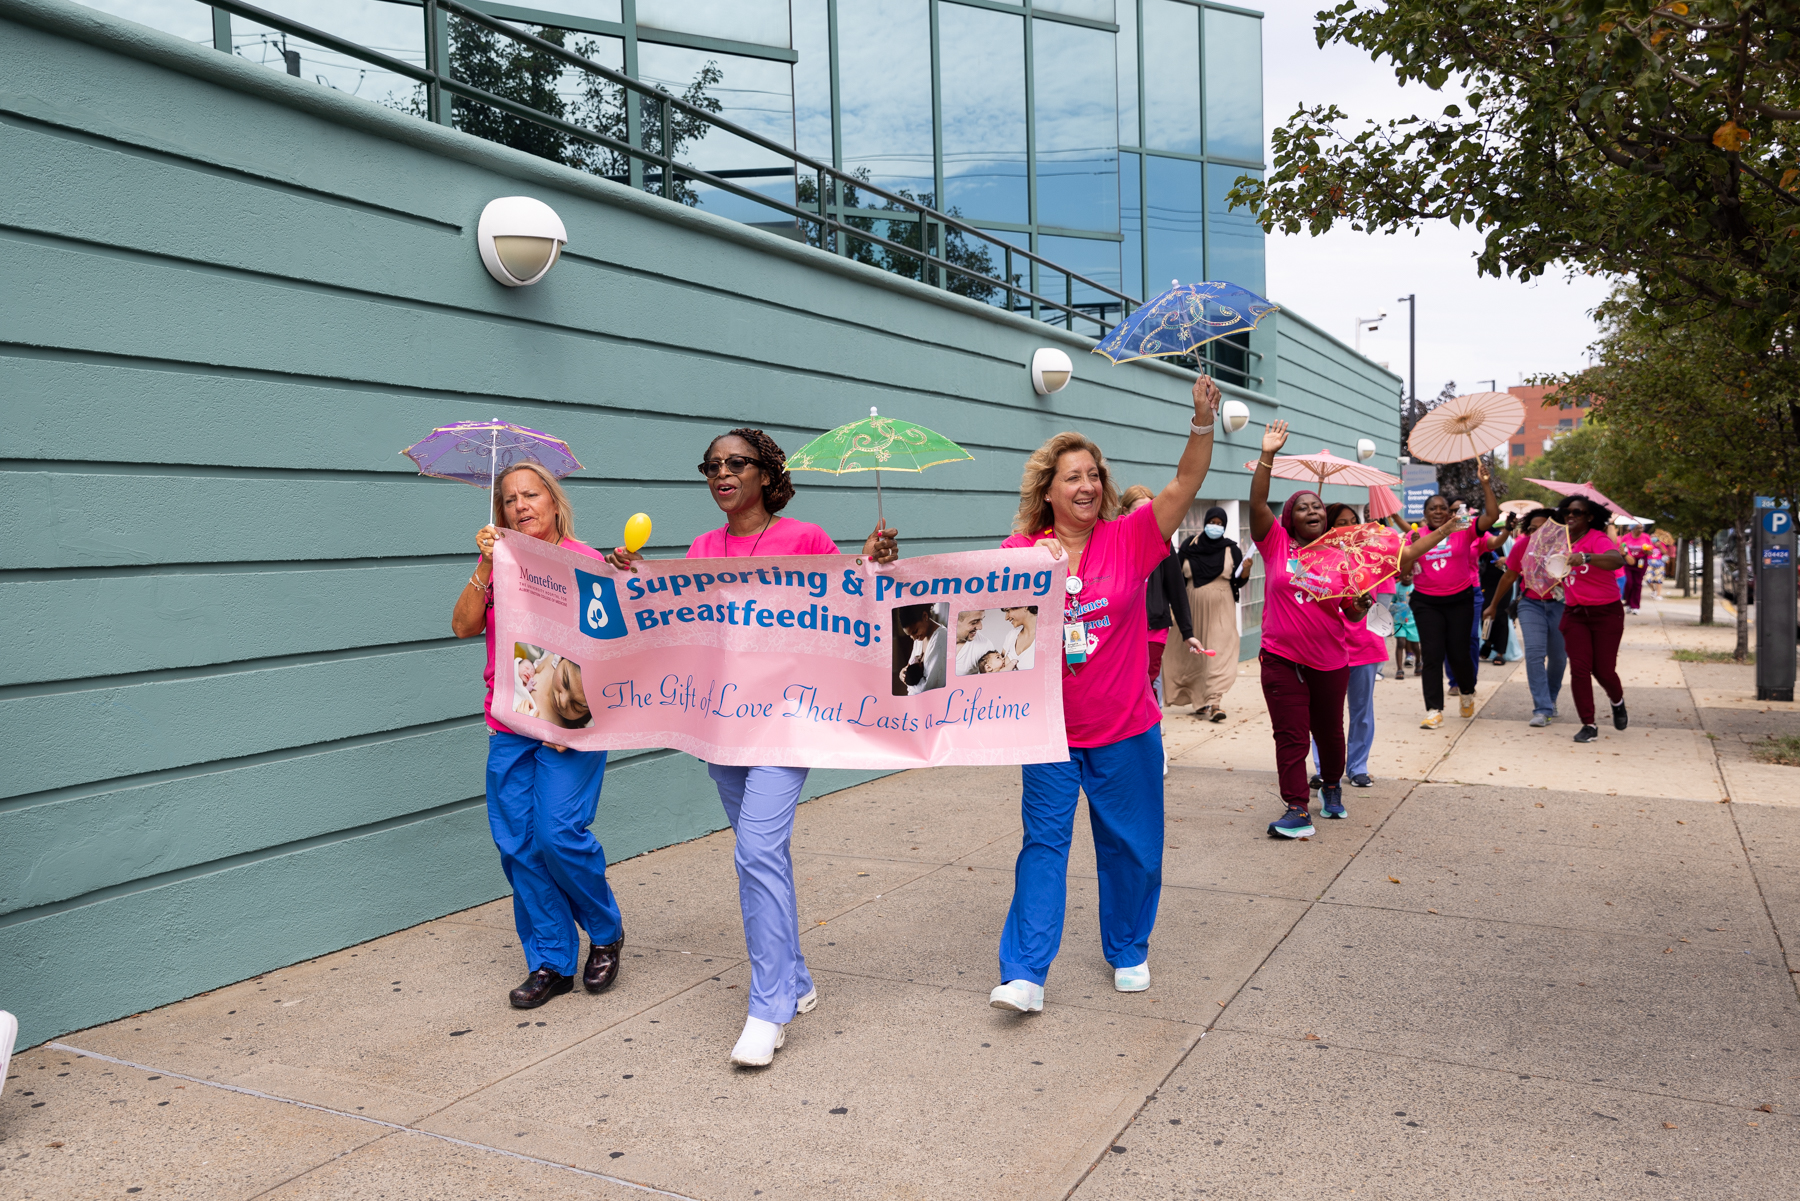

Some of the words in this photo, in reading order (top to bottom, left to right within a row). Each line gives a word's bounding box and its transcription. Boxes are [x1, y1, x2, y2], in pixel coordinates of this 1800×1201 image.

[1772, 513, 1787, 532] P
[520, 565, 567, 595] Montefiore
[626, 566, 828, 601] Supporting
[842, 569, 865, 597] &
[875, 566, 1053, 602] Promoting
[634, 600, 882, 647] Breastfeeding:
[602, 680, 652, 709] The
[659, 674, 697, 713] Gift
[699, 680, 715, 719] of
[712, 683, 773, 718] Love
[782, 684, 843, 722] That
[847, 695, 918, 732] Lasts
[925, 713, 933, 729] a
[935, 687, 1030, 729] Lifetime
